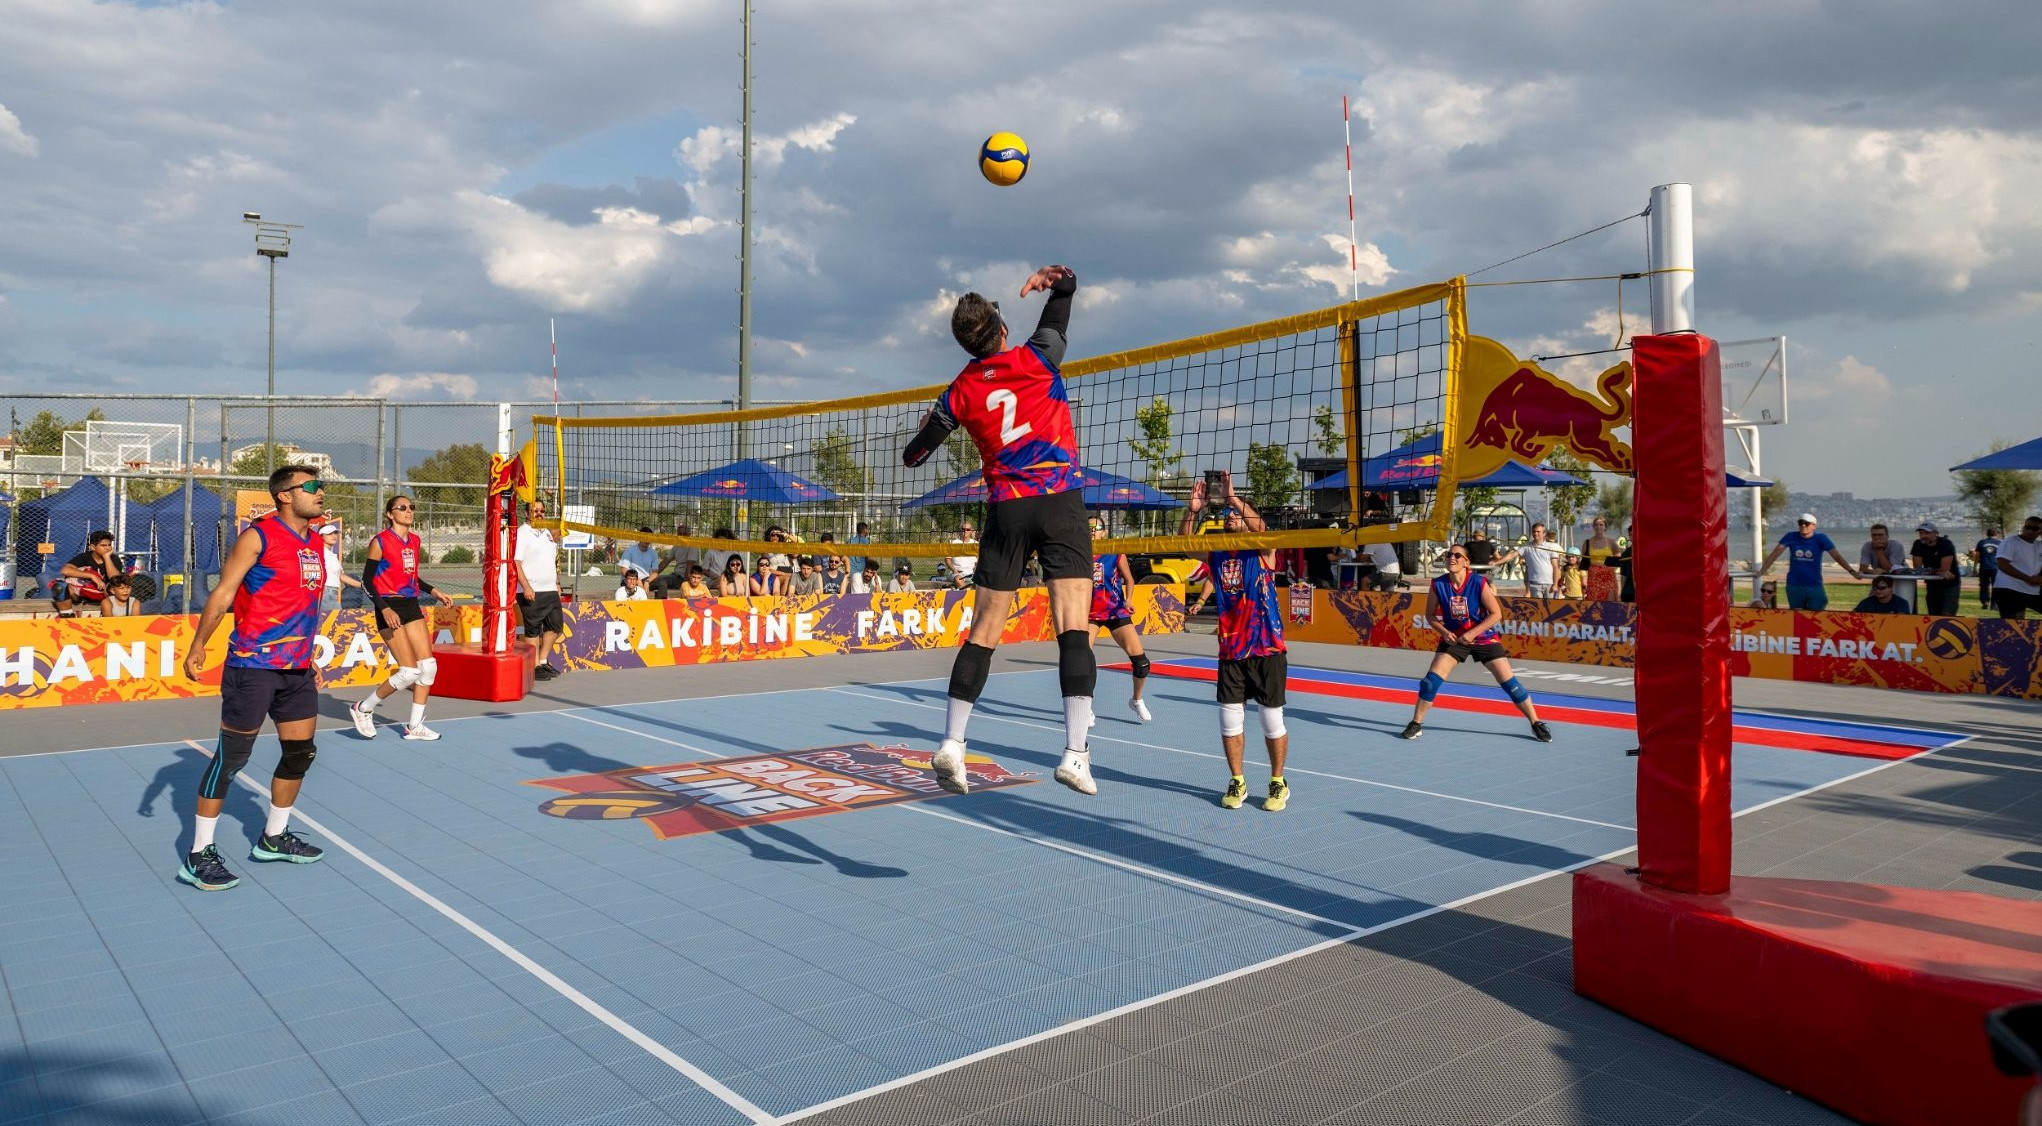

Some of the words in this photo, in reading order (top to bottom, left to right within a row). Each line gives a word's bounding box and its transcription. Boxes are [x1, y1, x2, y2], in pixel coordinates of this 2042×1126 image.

[985, 388, 1034, 446] 2
[605, 608, 813, 652] RAKİBİNE
[857, 608, 946, 638] FARK
[957, 606, 974, 632] A
[1493, 619, 1549, 637] AHANI
[1553, 622, 1635, 646] DARALT,
[1807, 637, 1879, 660] FARK
[1881, 643, 1924, 663] AT.
[629, 769, 821, 817] LINE
[717, 759, 896, 803] BACK
